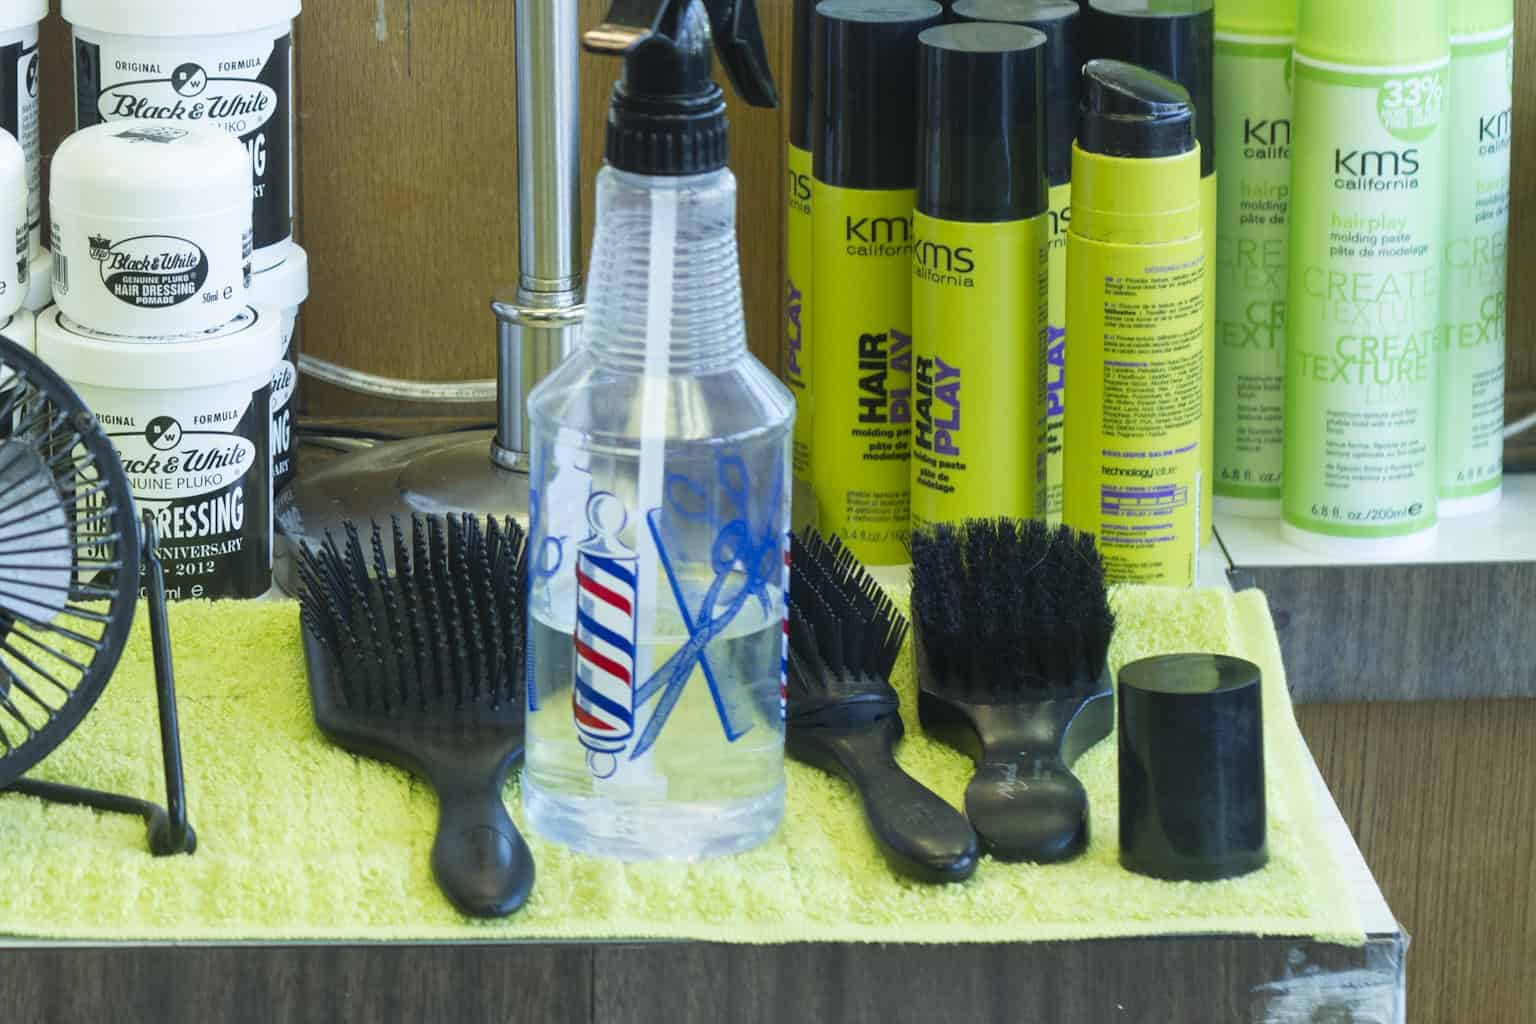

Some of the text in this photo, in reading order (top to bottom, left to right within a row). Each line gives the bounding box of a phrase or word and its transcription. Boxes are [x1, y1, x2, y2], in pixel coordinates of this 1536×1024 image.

[115, 60, 162, 74] ORIGINAL
[218, 57, 262, 72] FORMULA
[108, 93, 184, 120] Black
[205, 91, 268, 118] White
[1336, 148, 1419, 176] kms
[1334, 178, 1418, 191] california
[1240, 200, 1288, 213] molding
[1269, 214, 1285, 224] de
[1332, 208, 1407, 233] hairplay
[1330, 231, 1411, 245] molding paste
[846, 243, 912, 256] californ
[1359, 246, 1374, 256] de
[914, 268, 974, 288] alifornia
[115, 282, 195, 296] HAIR DRESSING
[136, 296, 174, 304] POMADE
[1296, 351, 1427, 385] TEXTURE
[859, 333, 888, 423] HAIR
[916, 356, 933, 450] HAIR
[934, 356, 960, 456] PLAY
[96, 413, 136, 426] RIGINAL
[194, 410, 238, 425] FORMULA
[120, 451, 160, 474] ack
[181, 444, 246, 472] White
[128, 473, 222, 490] NUINE PLUKO
[155, 538, 242, 559] NNIVERSARY
[176, 561, 214, 575] 2012
